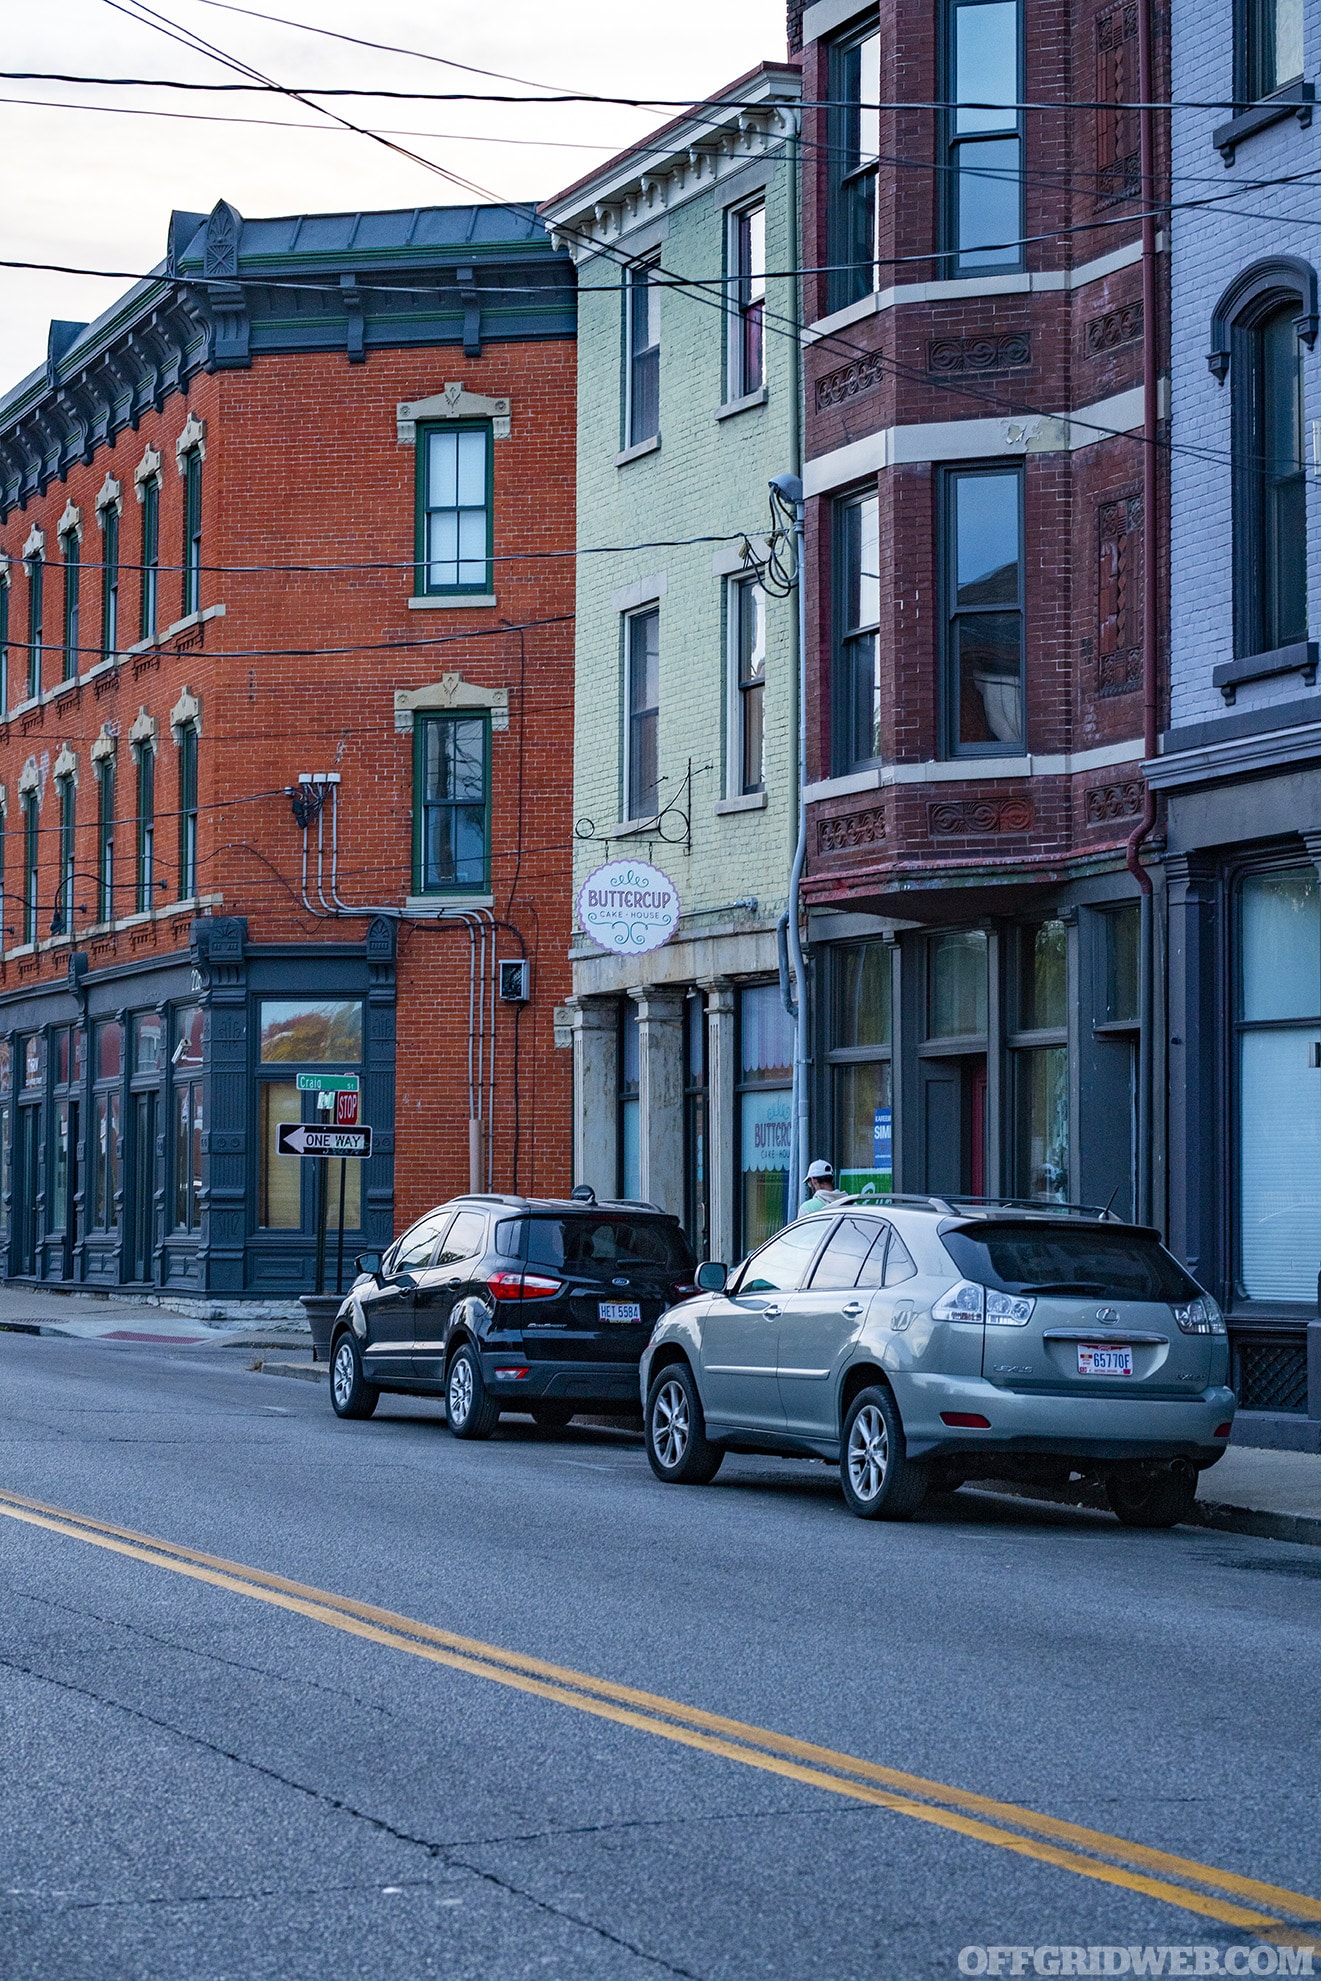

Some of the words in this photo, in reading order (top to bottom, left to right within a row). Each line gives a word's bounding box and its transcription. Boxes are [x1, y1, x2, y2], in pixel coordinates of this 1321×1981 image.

[588, 889, 671, 909] BUTTERCUP
[300, 1076, 322, 1089] Craig
[339, 1094, 357, 1120] STOP
[306, 1134, 330, 1147] ONE
[335, 1135, 361, 1148] WAY
[601, 1305, 616, 1318] HET
[618, 1305, 639, 1318] 5584
[1094, 1352, 1130, 1369] 65770F
